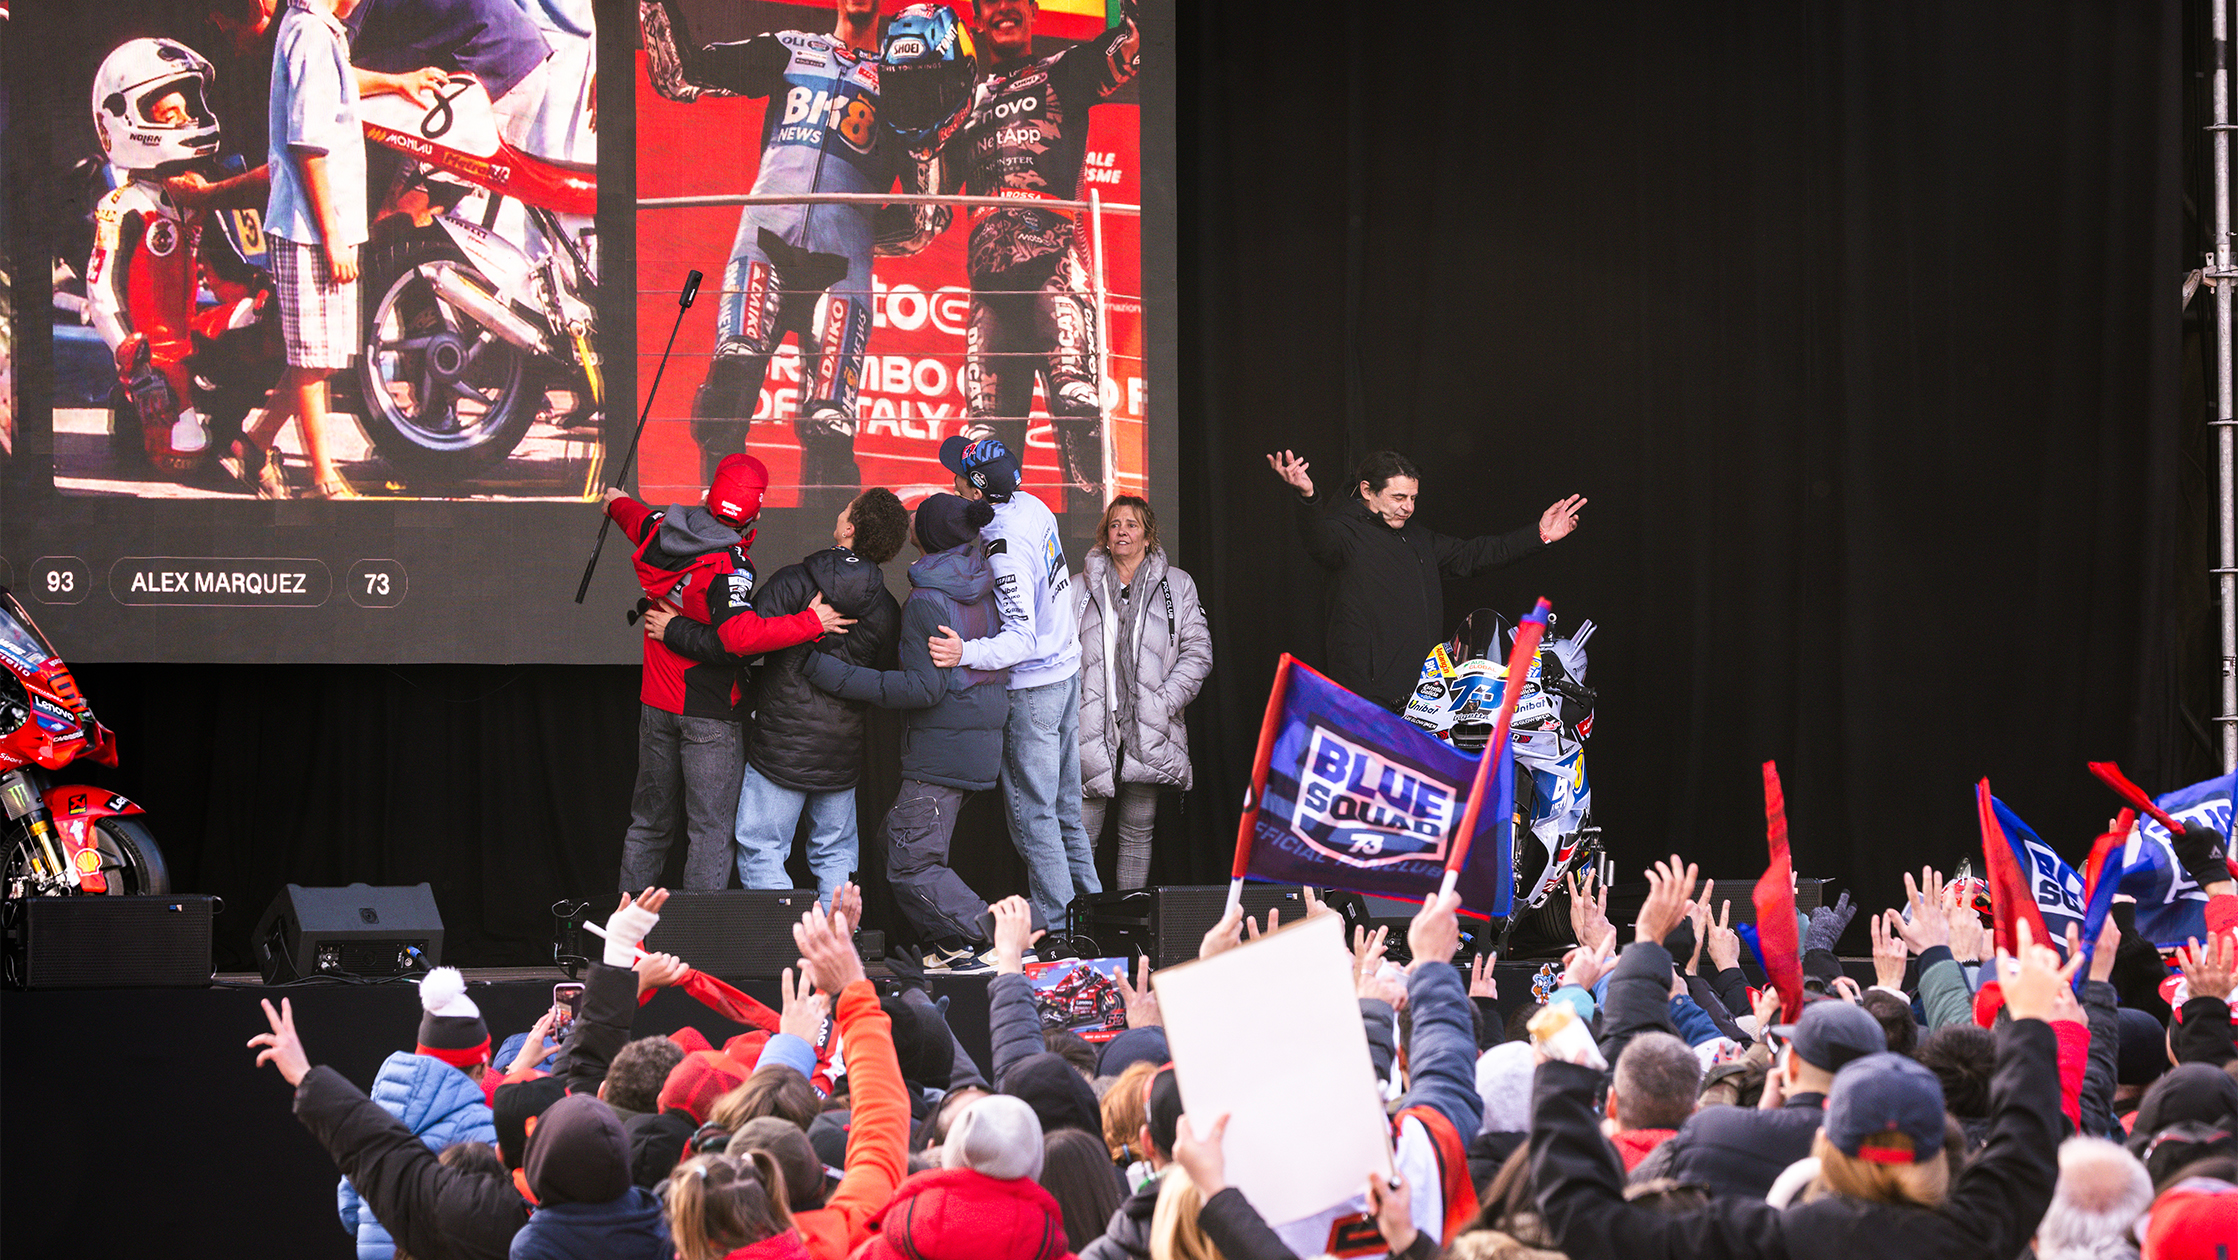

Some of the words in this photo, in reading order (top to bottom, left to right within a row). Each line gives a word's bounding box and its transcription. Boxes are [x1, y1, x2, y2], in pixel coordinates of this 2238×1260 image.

[385, 133, 433, 155] MONLAU
[777, 126, 823, 144] NEWS
[977, 127, 1041, 154] NetApp
[968, 326, 984, 410] DUCAT
[855, 396, 951, 440] TALY
[46, 570, 75, 592] 93
[130, 571, 190, 593] ALEX
[195, 571, 307, 595] MARQUEZ
[364, 573, 391, 595] 73
[1447, 675, 1506, 712] 73
[34, 695, 75, 721] Lenovo
[1313, 735, 1447, 821] BLUE
[1304, 781, 1441, 837] SQUAD
[1255, 821, 1325, 864] FFICIAL
[1349, 833, 1385, 855] 73
